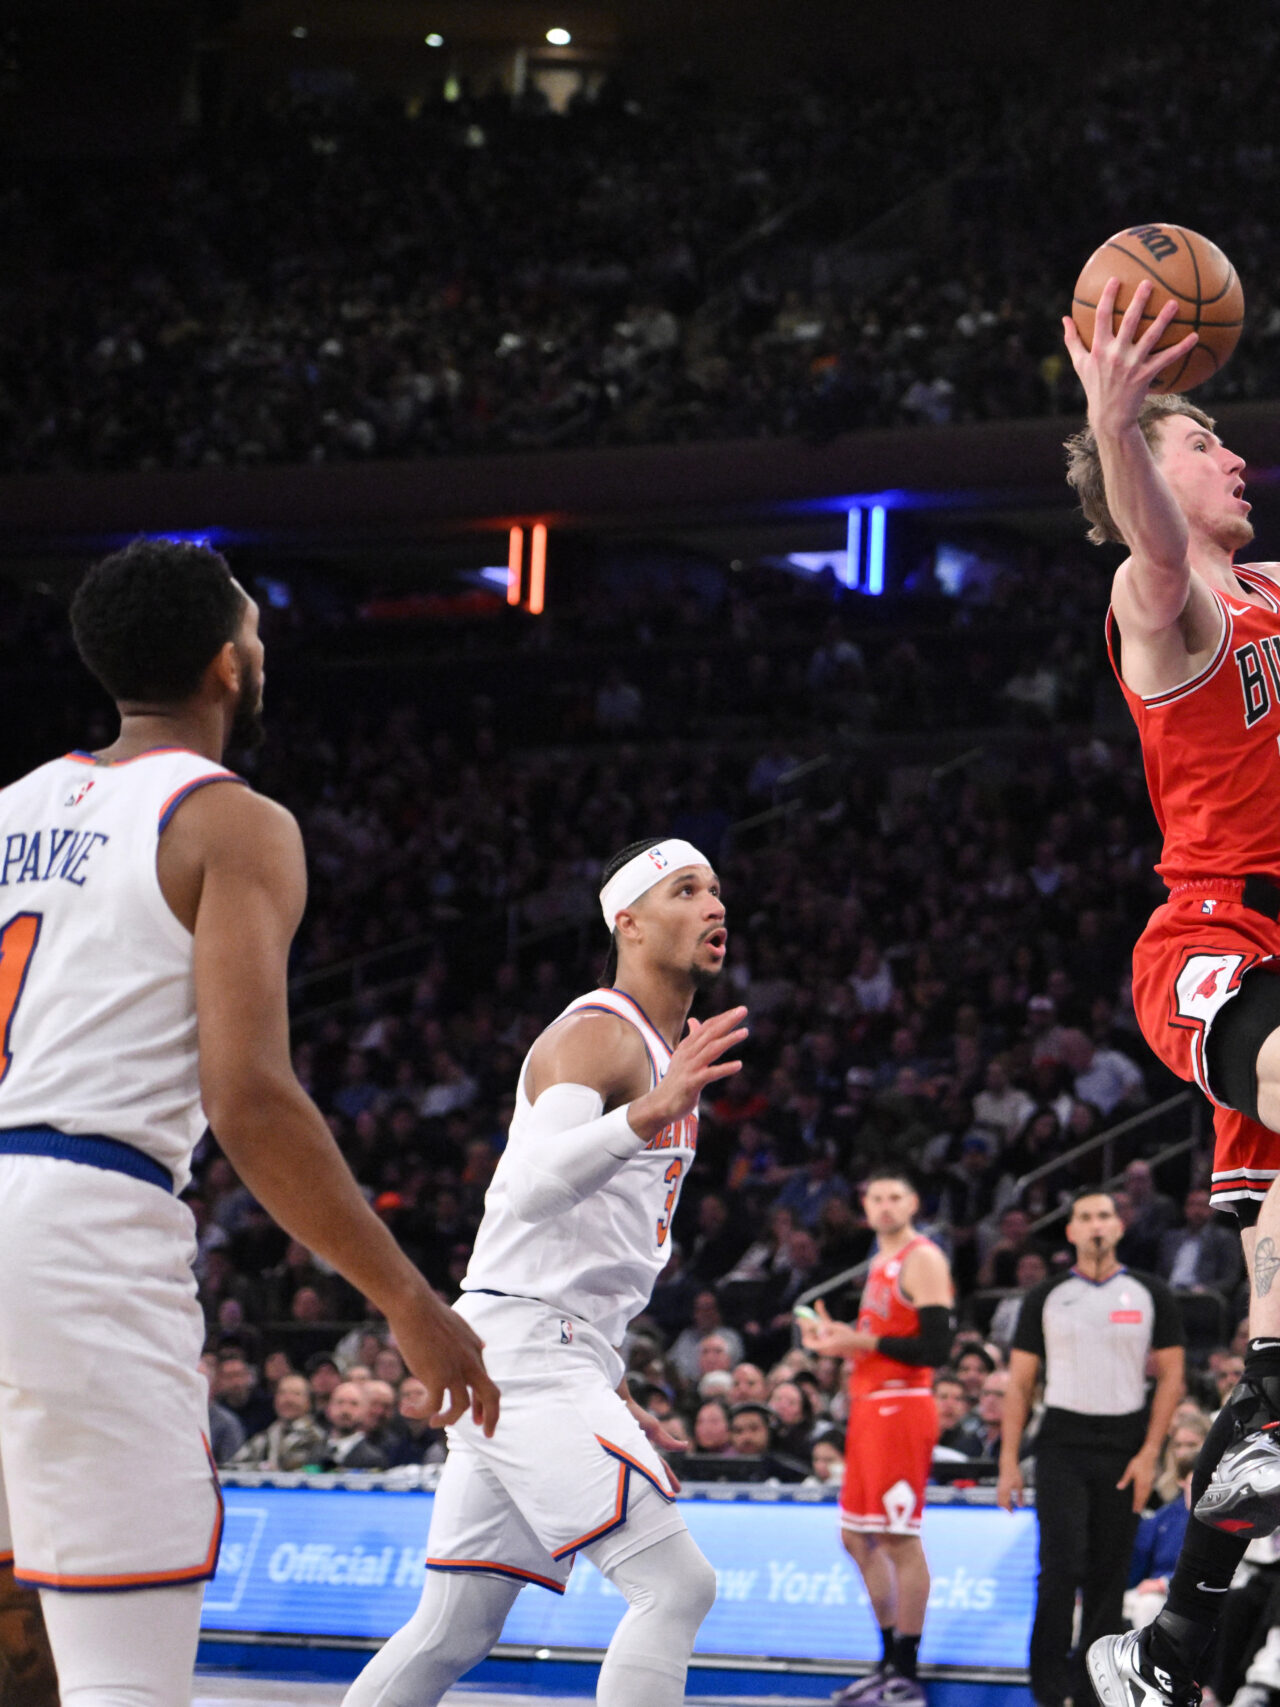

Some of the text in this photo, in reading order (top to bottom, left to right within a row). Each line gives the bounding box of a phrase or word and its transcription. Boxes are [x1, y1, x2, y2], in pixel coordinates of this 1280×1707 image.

[0, 829, 109, 887] PAYNE
[657, 1157, 682, 1247] 3
[268, 1542, 394, 1587] Official
[715, 1559, 998, 1611] ew York cks
